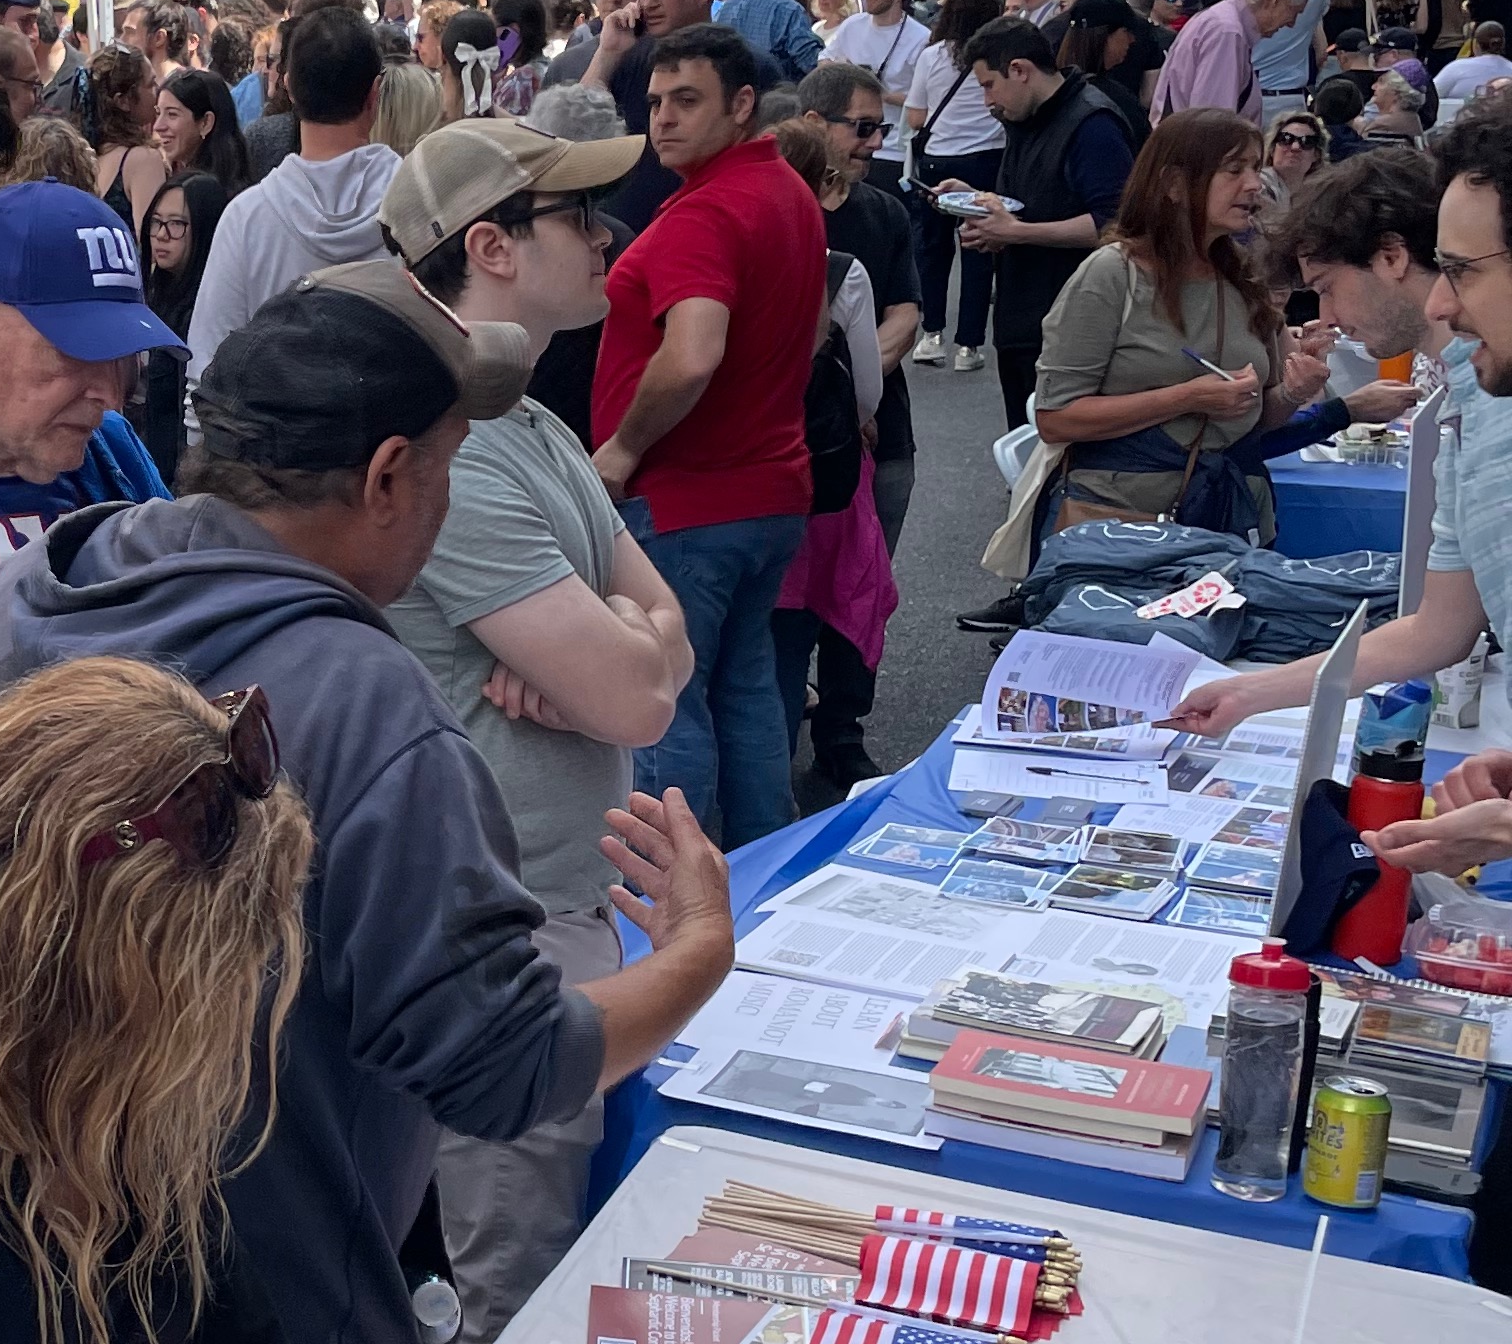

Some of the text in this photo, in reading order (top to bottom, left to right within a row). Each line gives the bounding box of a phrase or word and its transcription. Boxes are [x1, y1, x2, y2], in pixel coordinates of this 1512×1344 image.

[736, 981, 777, 1017] MUSIC
[811, 992, 849, 1029] ABOUT
[853, 997, 890, 1033] LEARN
[646, 1293, 662, 1330] Sephardic
[663, 1295, 678, 1330] Welcome
[679, 1296, 694, 1344] Bienvenidos!
[663, 1330, 676, 1339] to
